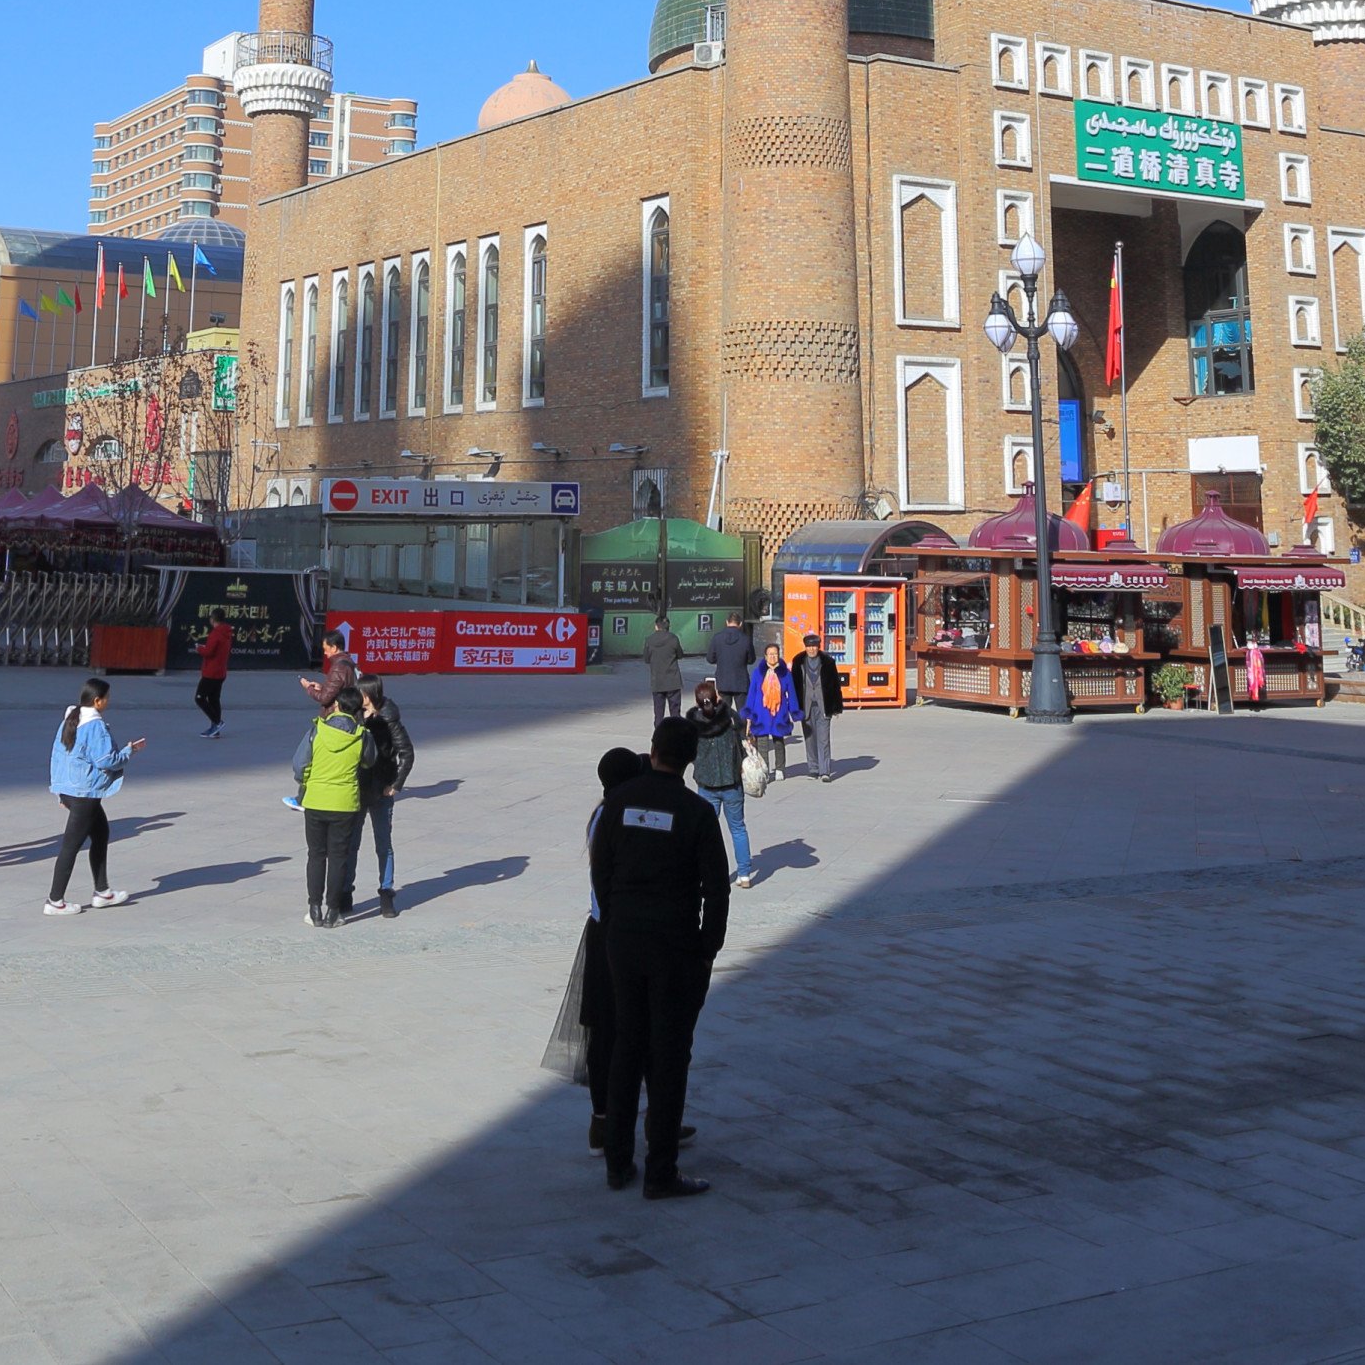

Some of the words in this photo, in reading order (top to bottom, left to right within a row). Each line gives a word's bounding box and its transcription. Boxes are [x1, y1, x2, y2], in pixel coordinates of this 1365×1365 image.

[1084, 146, 1242, 192] 二道桥清真寺
[371, 489, 409, 504] EXIT
[423, 487, 464, 507] 出口
[591, 580, 651, 592] 停车场入口
[362, 627, 436, 637] 进入大巴扎广场院
[456, 620, 538, 636] Carrefour
[366, 639, 435, 649] 内到1号楼步行街
[365, 651, 430, 661] 进入家乐福超市
[462, 648, 514, 665] 家乐福
